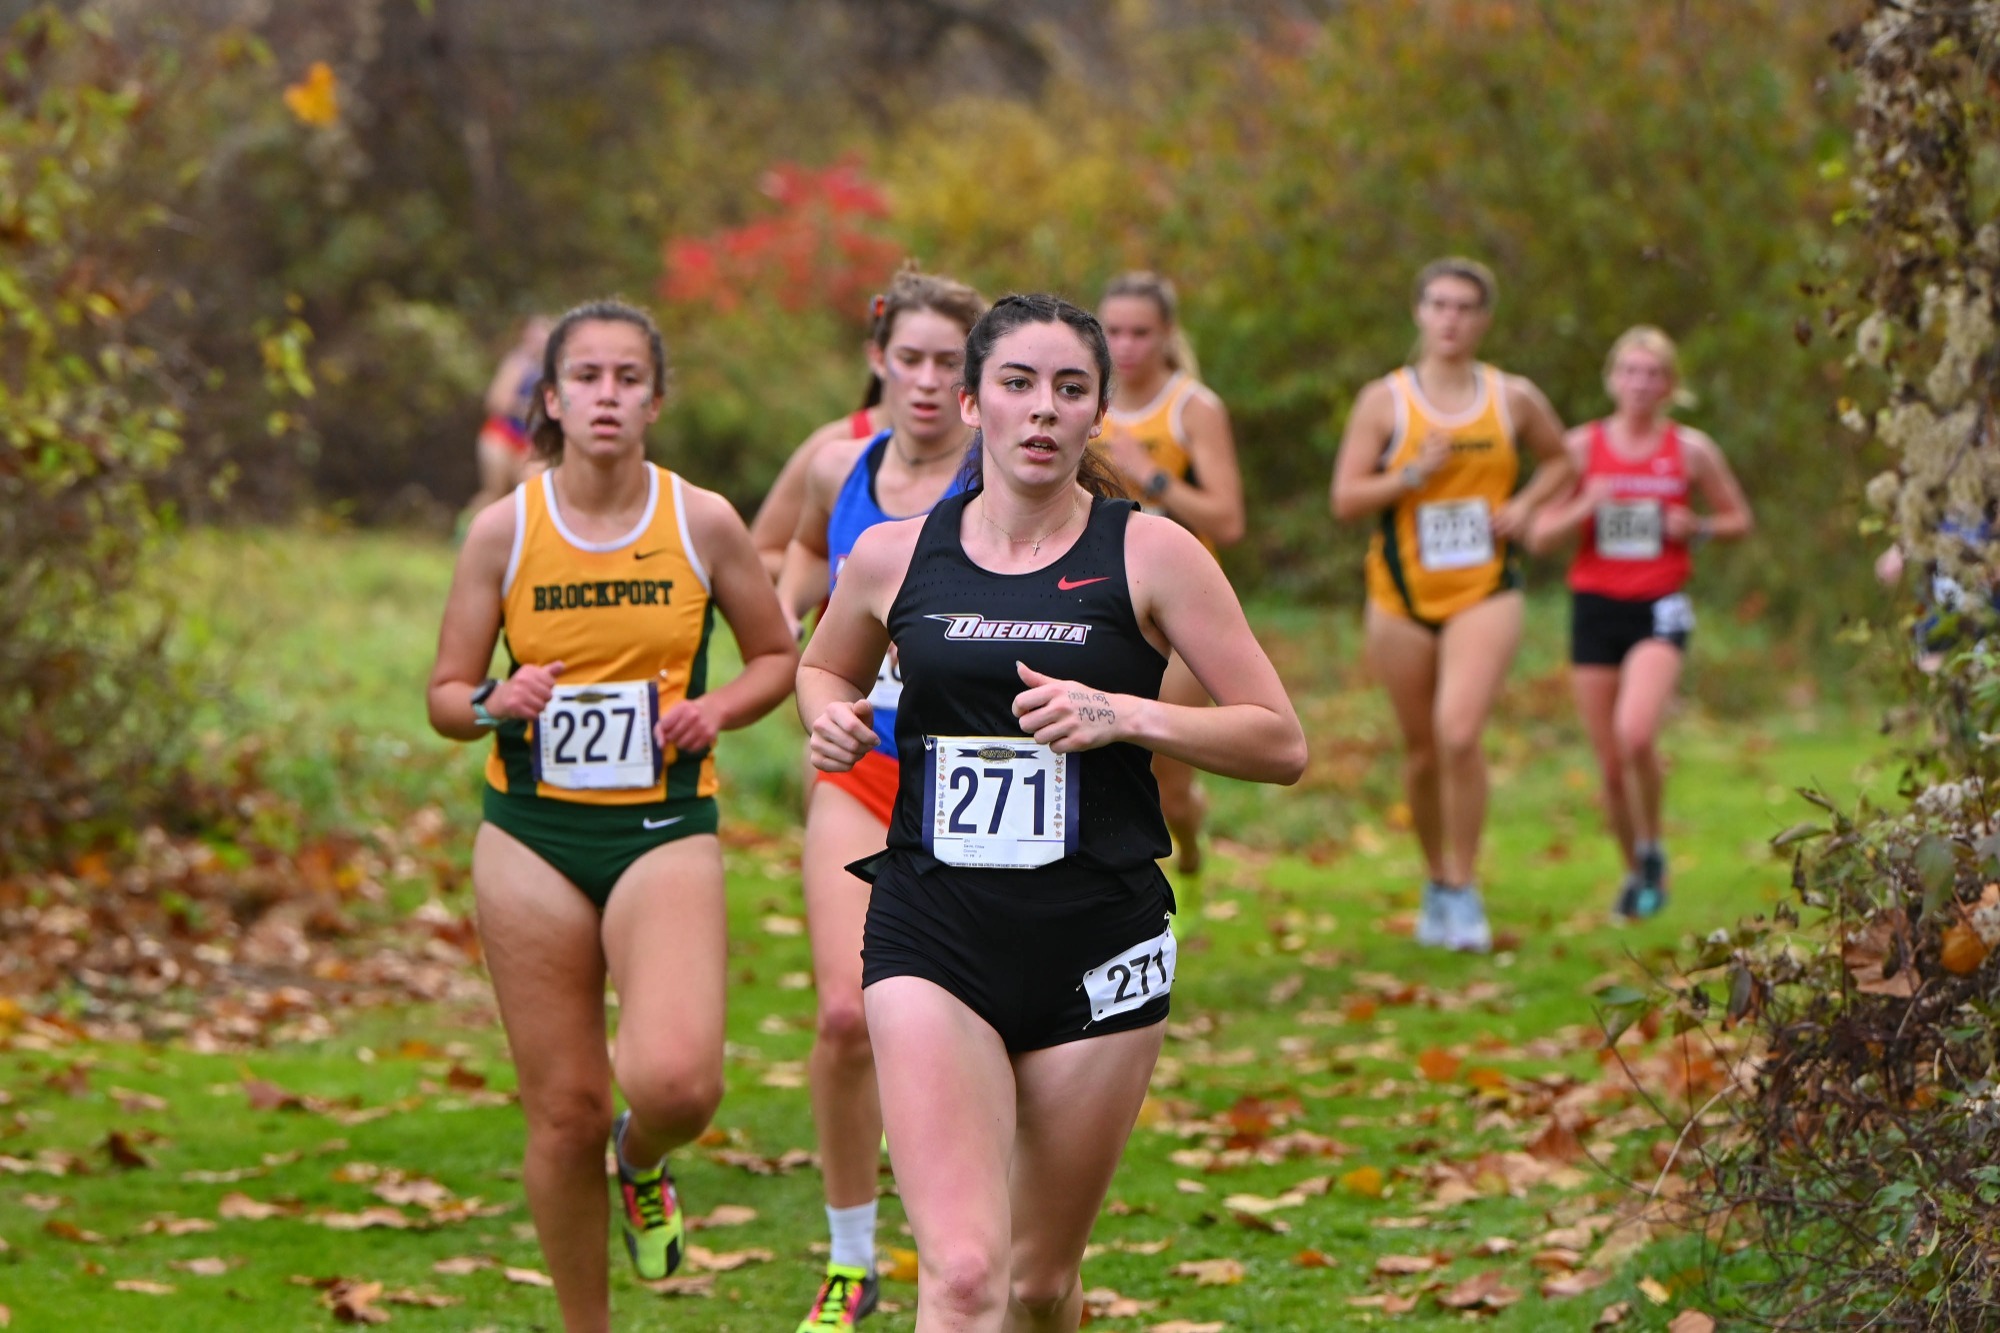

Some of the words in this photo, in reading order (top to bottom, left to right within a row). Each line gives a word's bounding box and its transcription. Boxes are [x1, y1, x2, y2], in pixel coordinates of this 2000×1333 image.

[533, 580, 674, 612] BROCKPORT
[552, 706, 637, 764] 227
[1078, 707, 1096, 722] Put
[1097, 708, 1116, 725] God
[948, 767, 1047, 836] 271
[1107, 947, 1167, 1004] 271
